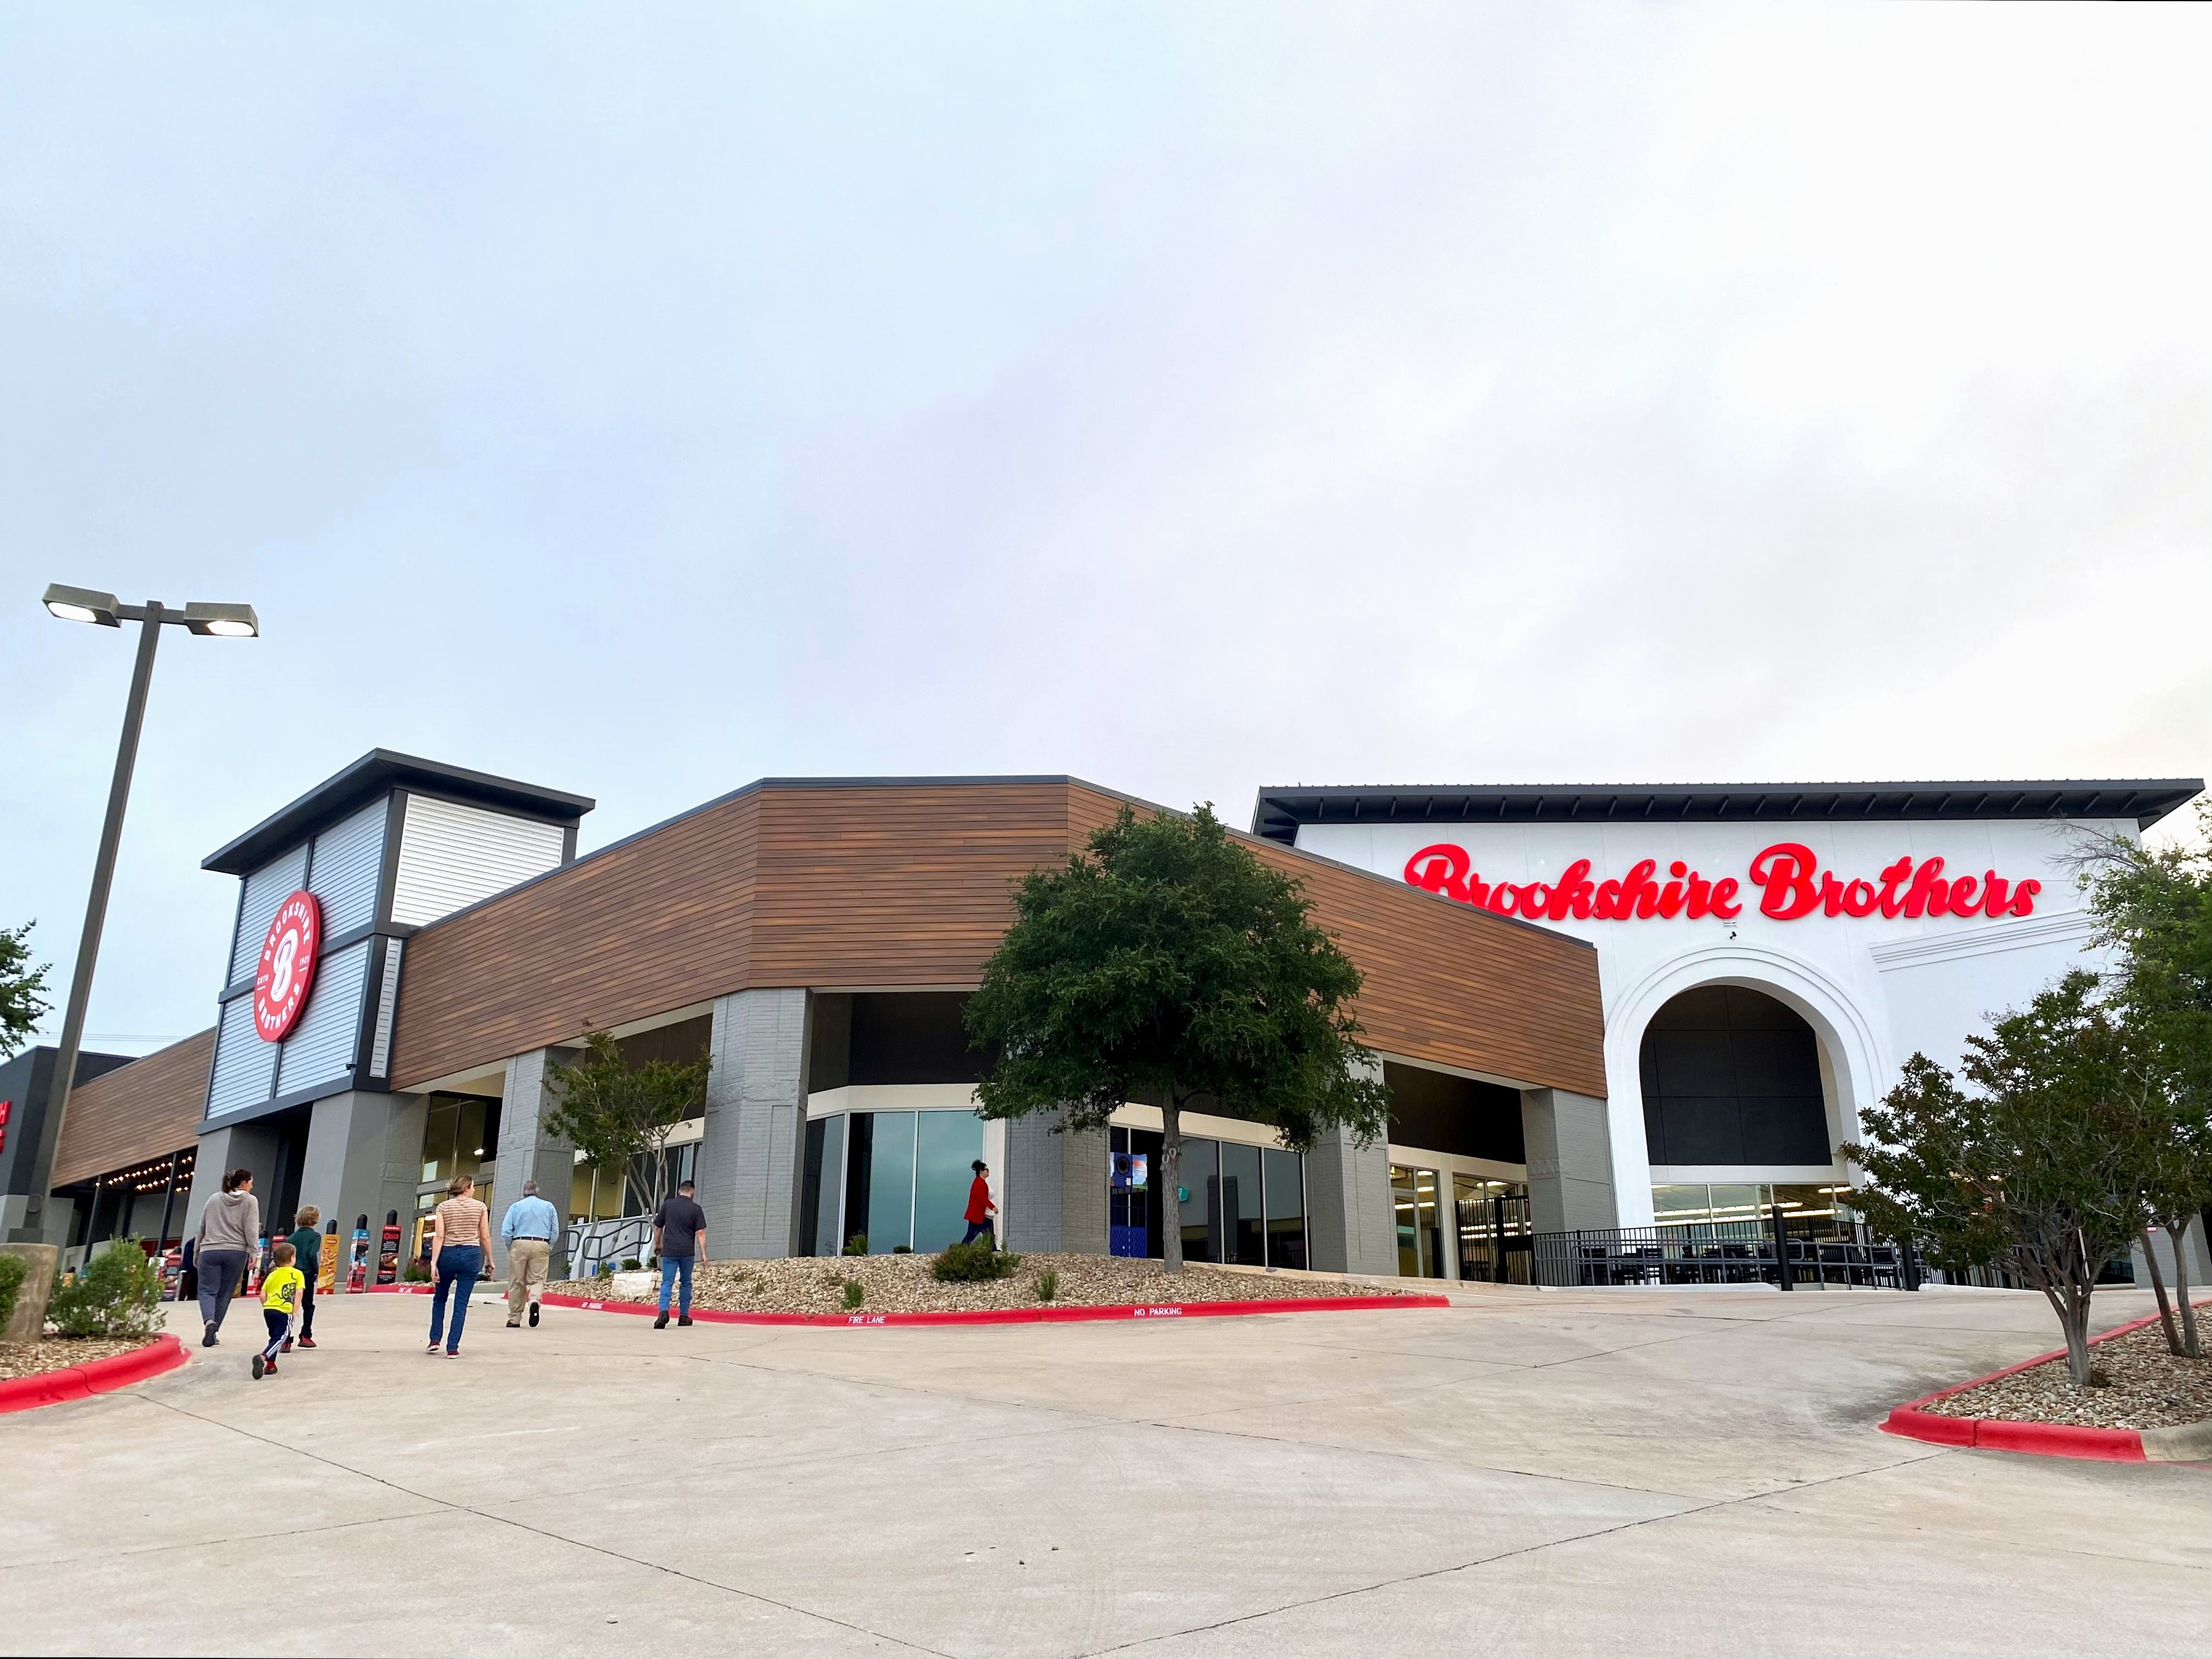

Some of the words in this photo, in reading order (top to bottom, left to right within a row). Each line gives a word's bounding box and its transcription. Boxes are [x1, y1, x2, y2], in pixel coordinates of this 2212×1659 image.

[1404, 843, 1742, 920] Brookshire
[1750, 842, 2041, 920] Brothers
[264, 901, 310, 961] BROOKSHIRE
[299, 955, 310, 966] 1921
[257, 973, 269, 986] ESTD
[258, 982, 300, 1031] BROTHERS
[1134, 1308, 1146, 1317] NO
[1149, 1307, 1182, 1316] PARKING
